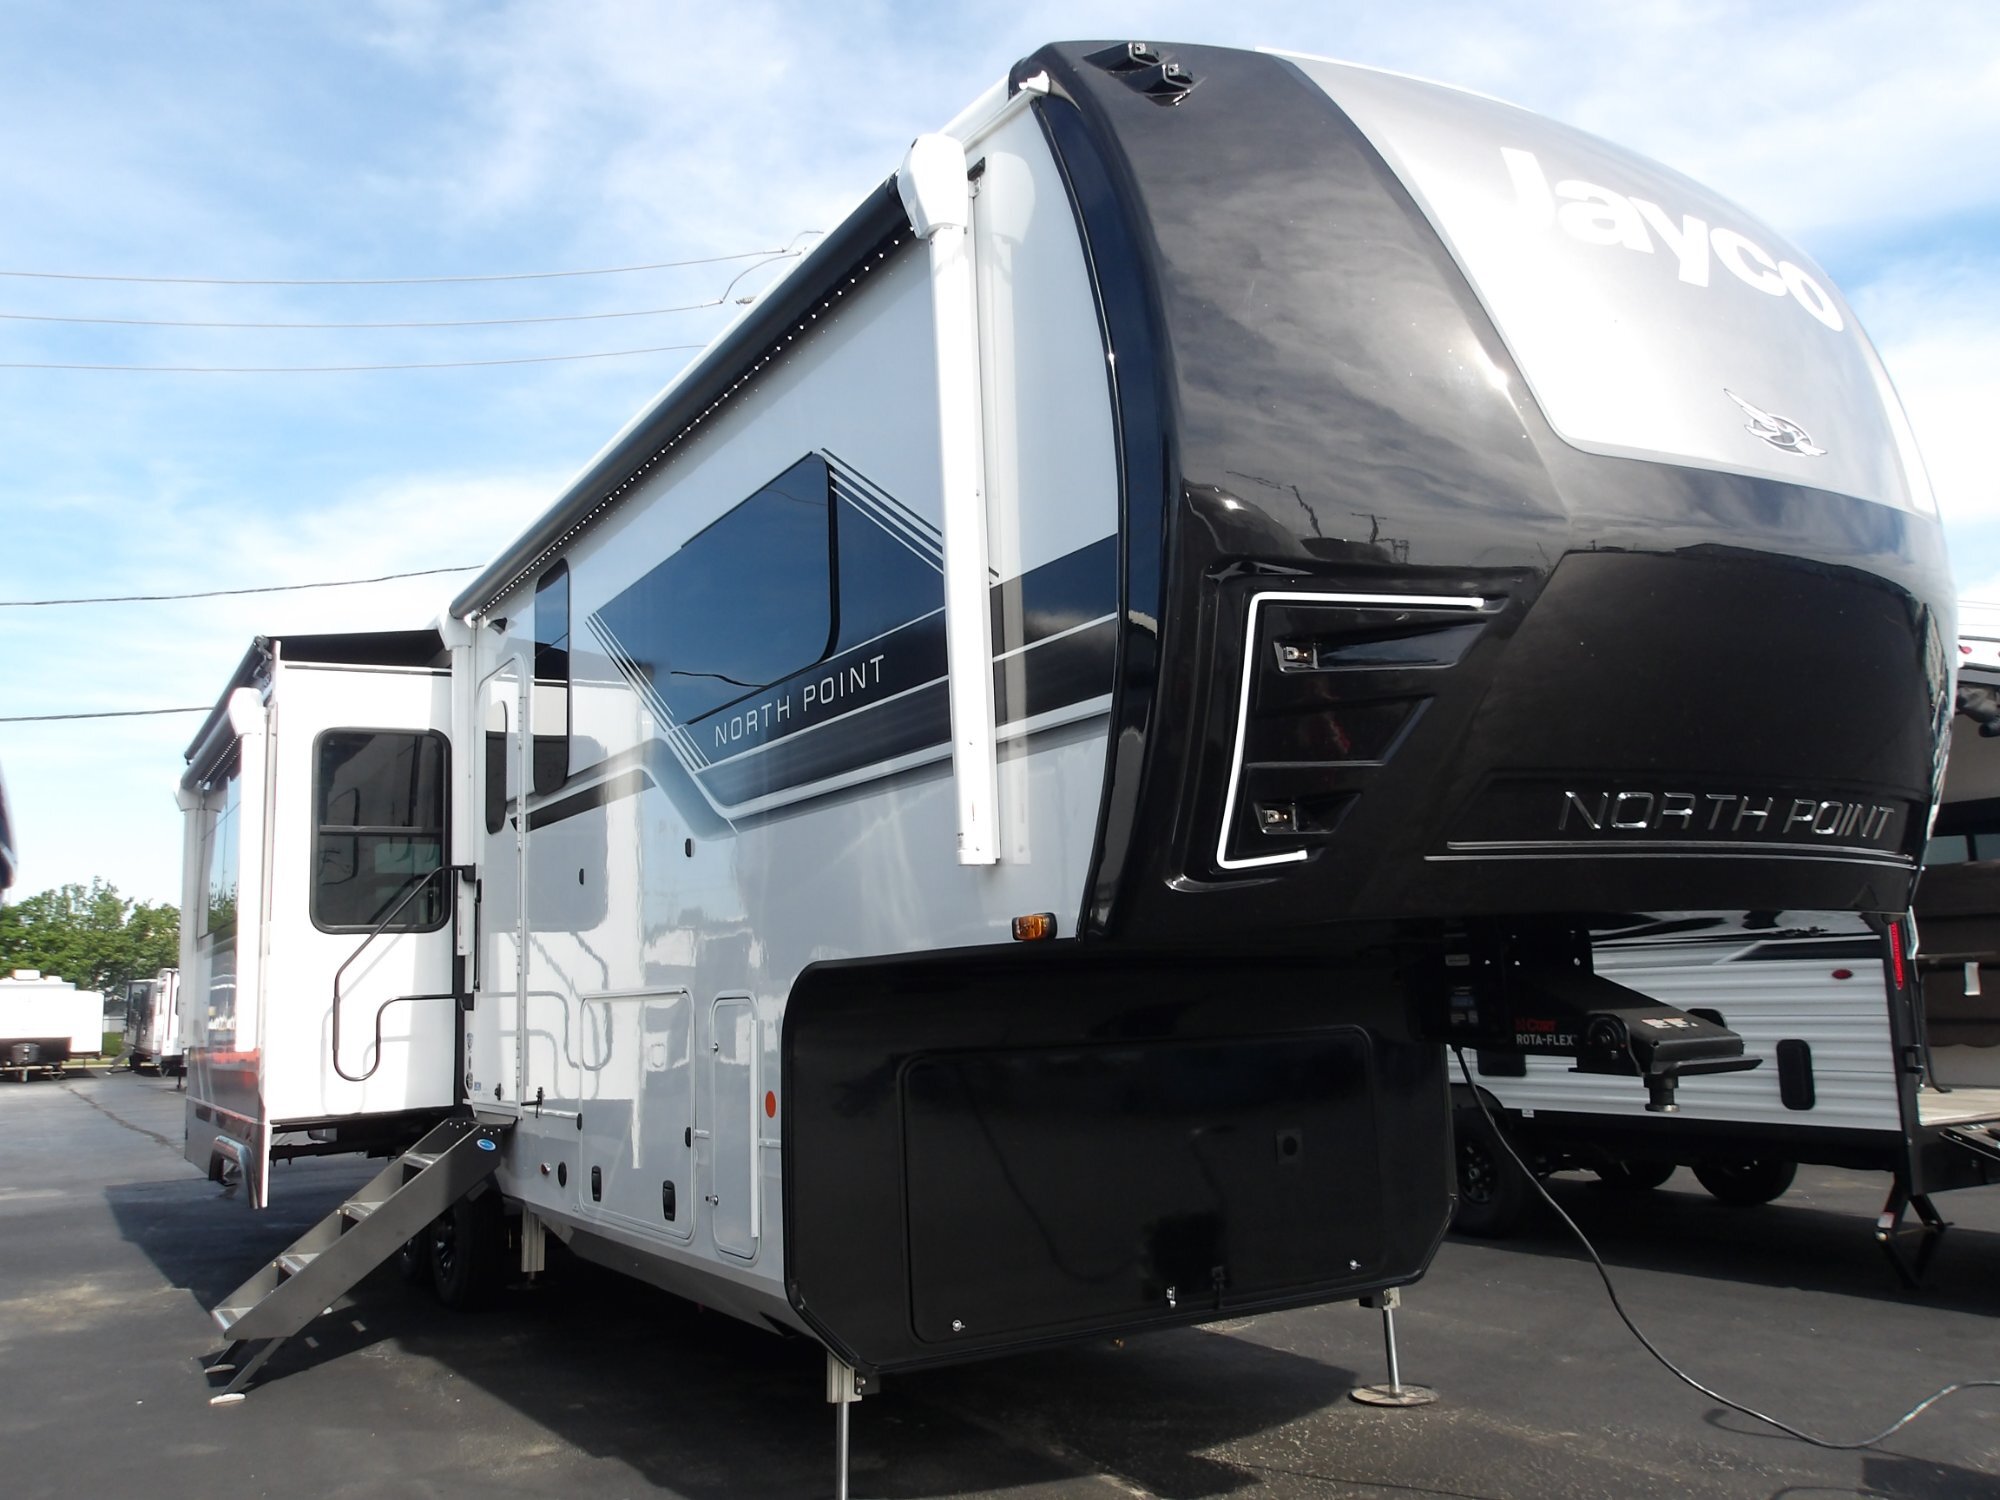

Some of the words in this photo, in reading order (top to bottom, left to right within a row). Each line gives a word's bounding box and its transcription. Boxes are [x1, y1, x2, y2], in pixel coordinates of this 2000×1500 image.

[1500, 146, 1844, 332] Jayco
[715, 695, 790, 748] NORTH
[803, 654, 885, 712] POINT
[1558, 790, 1774, 832] NORTH
[1782, 798, 1896, 840] POINT
